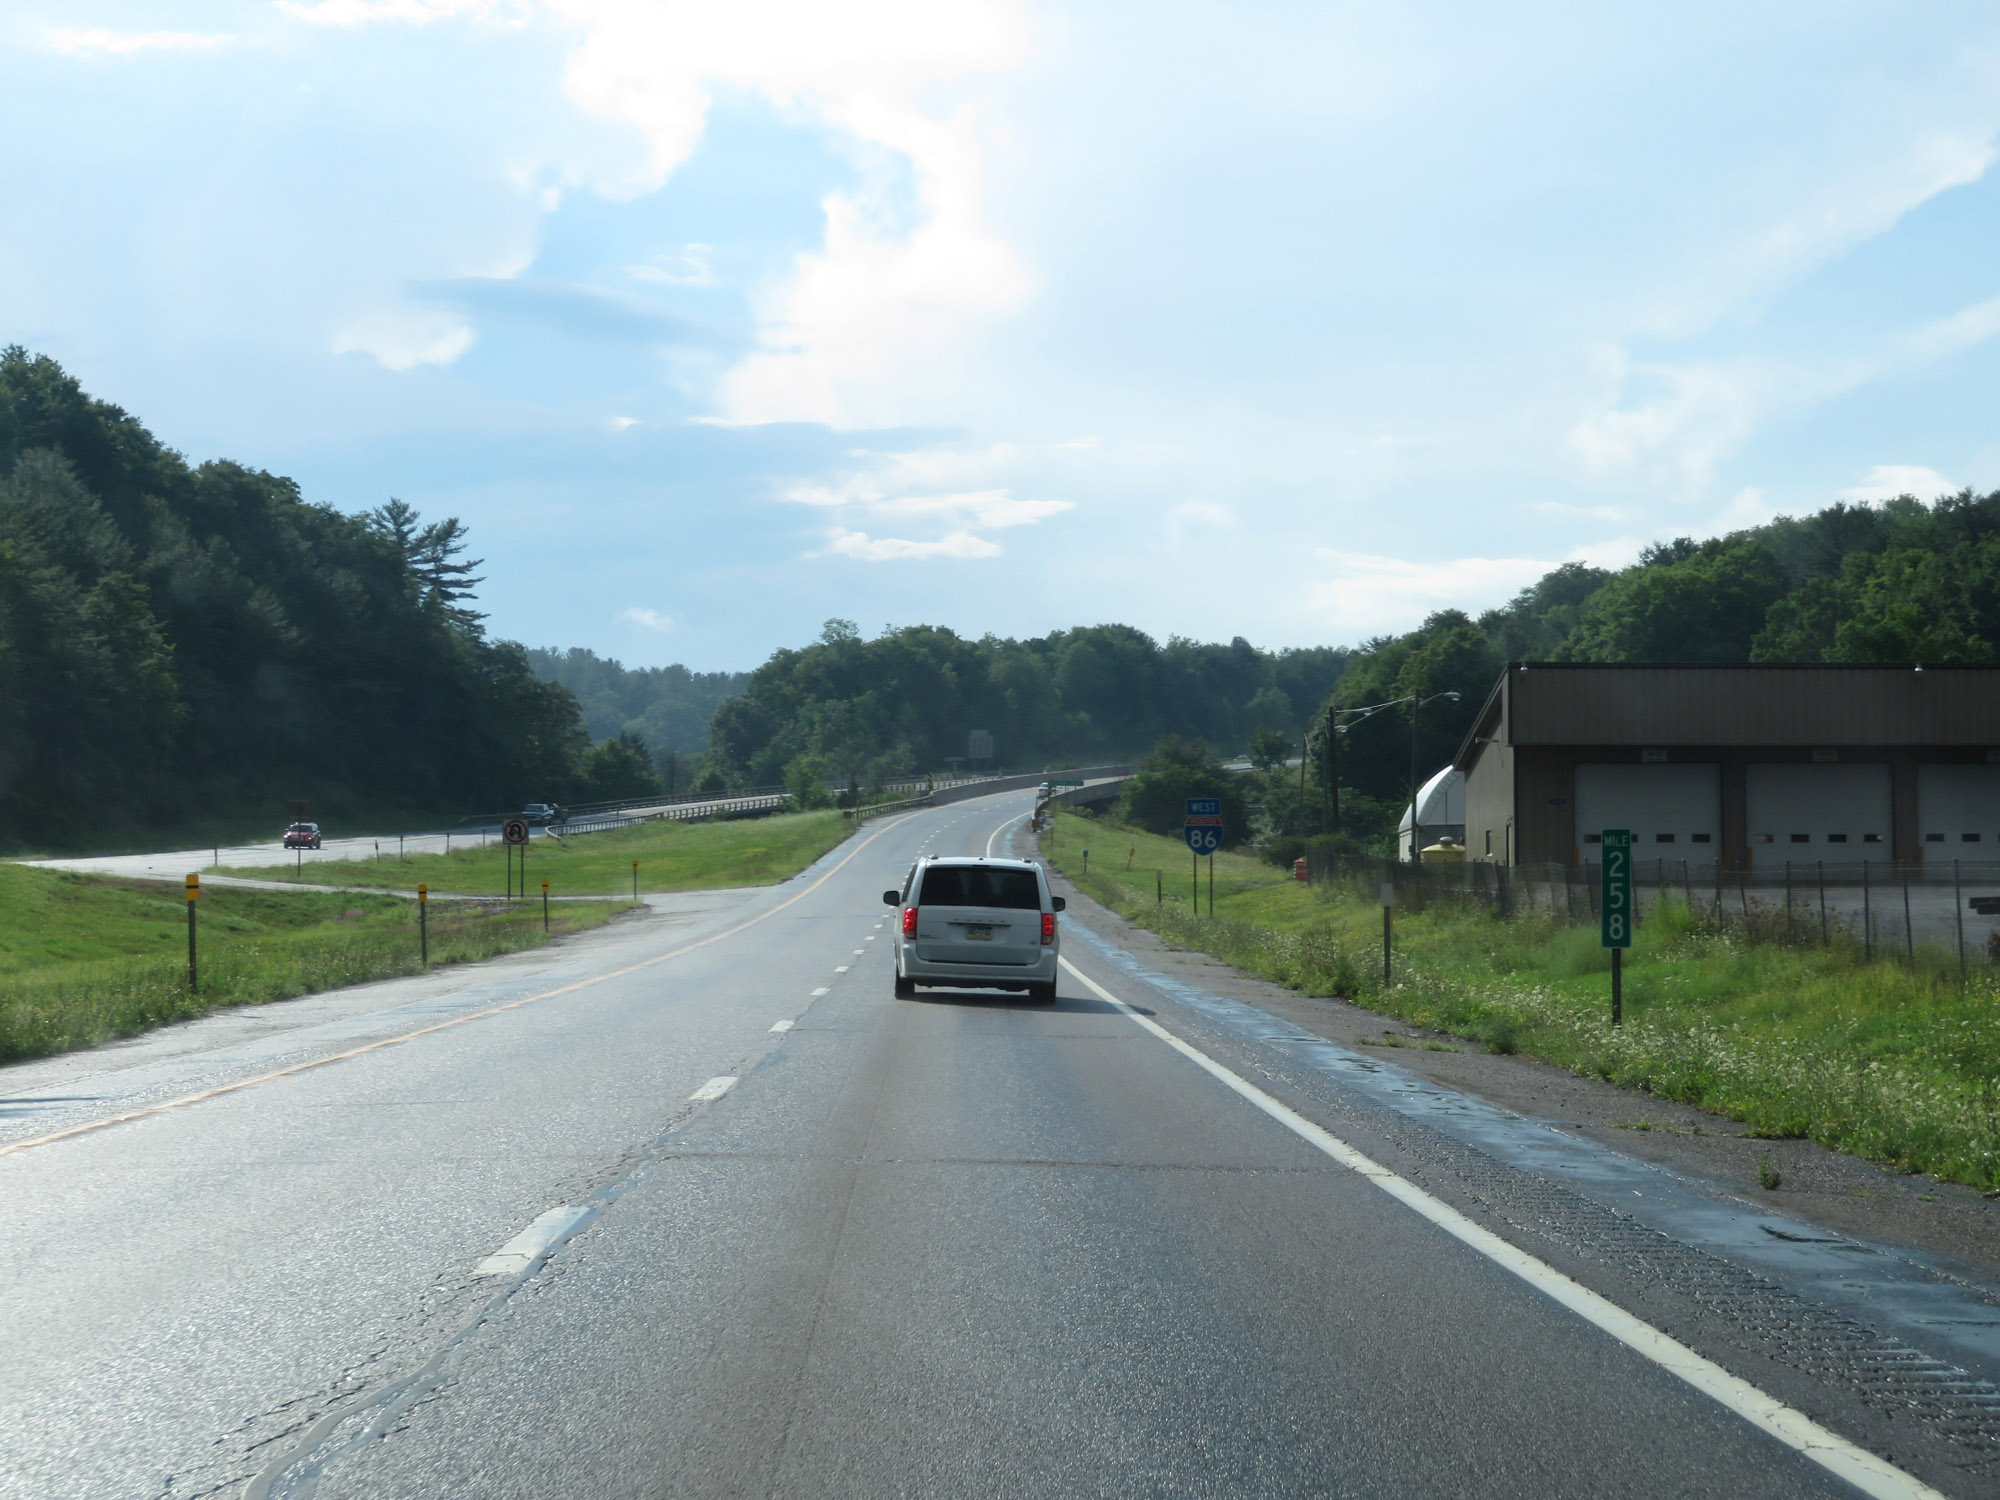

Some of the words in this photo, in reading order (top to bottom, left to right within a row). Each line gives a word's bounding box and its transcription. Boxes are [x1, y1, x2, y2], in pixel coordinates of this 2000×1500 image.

[1191, 802, 1216, 812] WEST
[1191, 829, 1217, 848] 86
[1604, 835, 1629, 847] MILE
